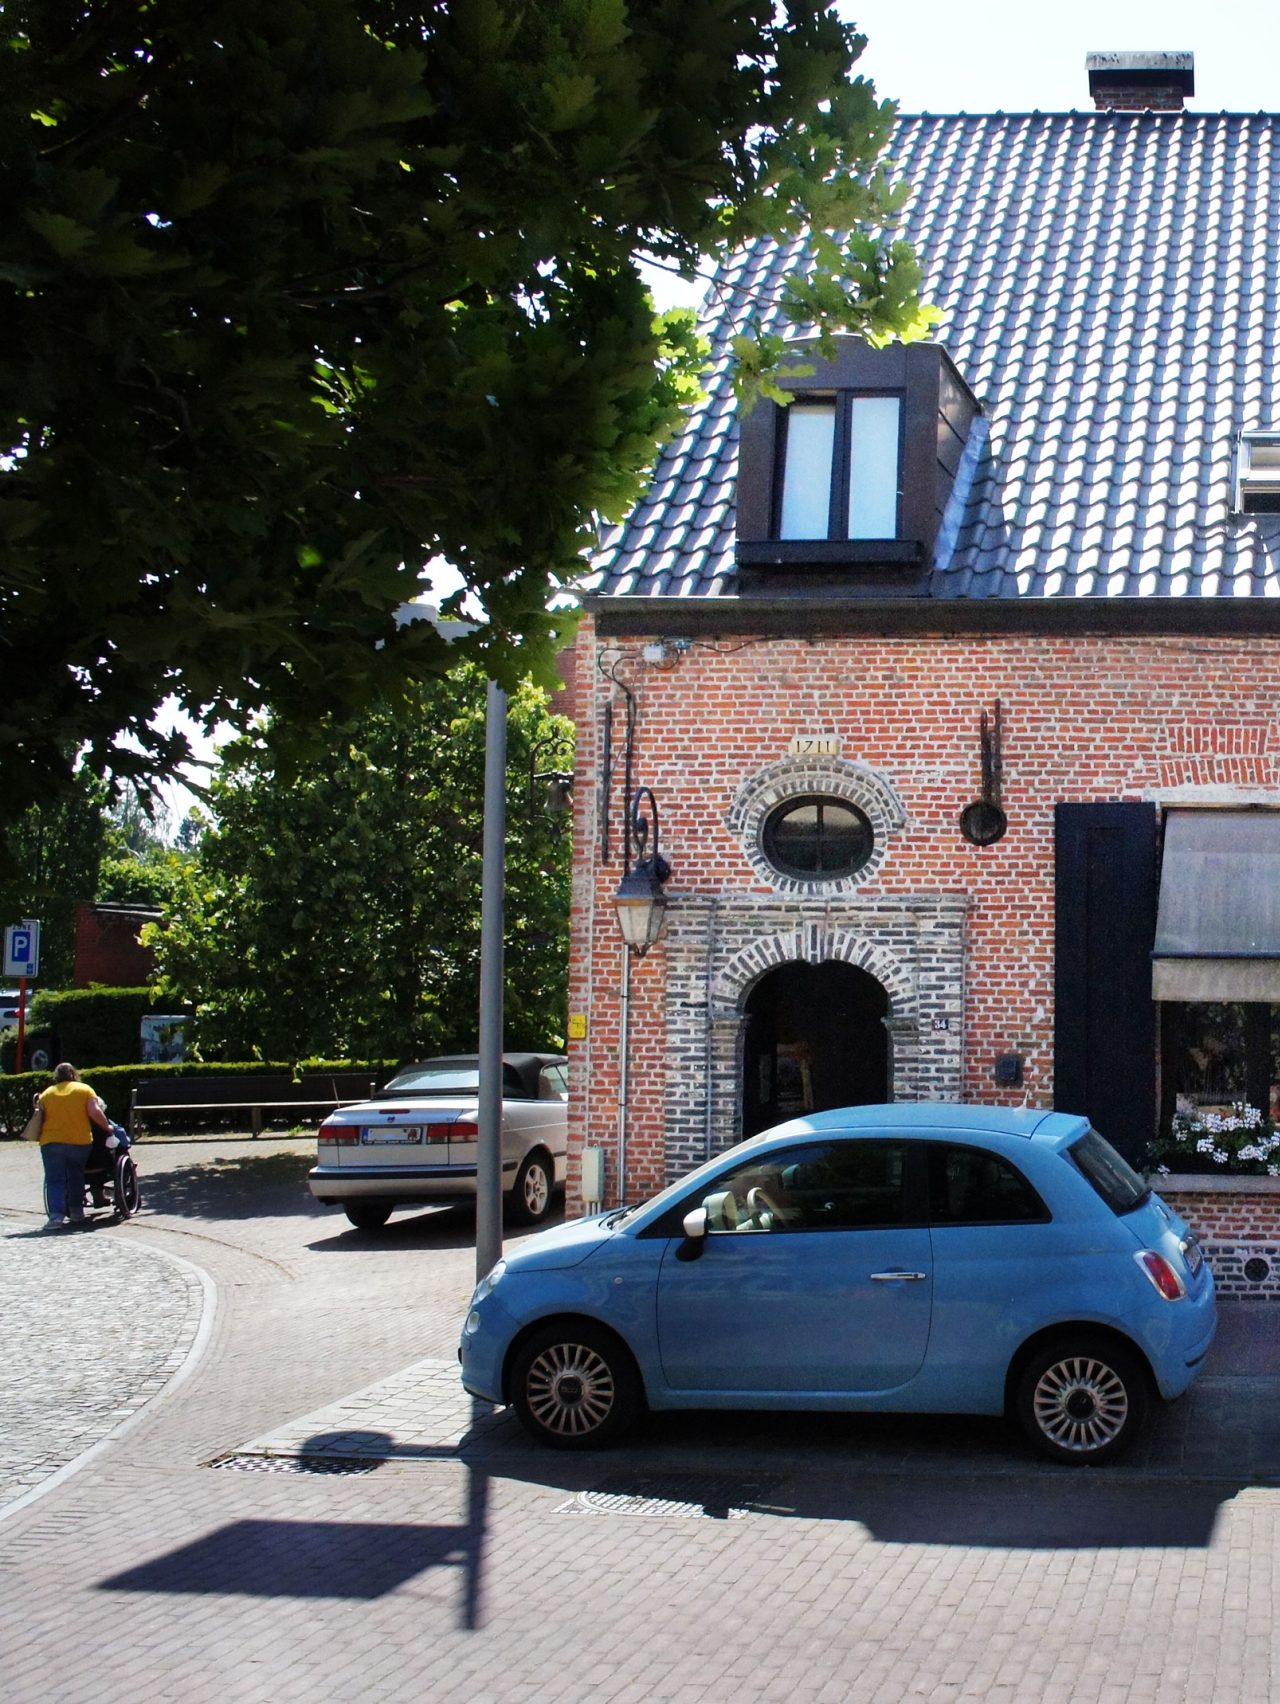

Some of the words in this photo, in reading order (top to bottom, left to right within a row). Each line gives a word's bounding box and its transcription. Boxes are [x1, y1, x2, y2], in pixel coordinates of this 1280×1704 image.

[796, 740, 830, 753] 1711
[14, 936, 28, 957] P
[934, 1019, 946, 1029] 34
